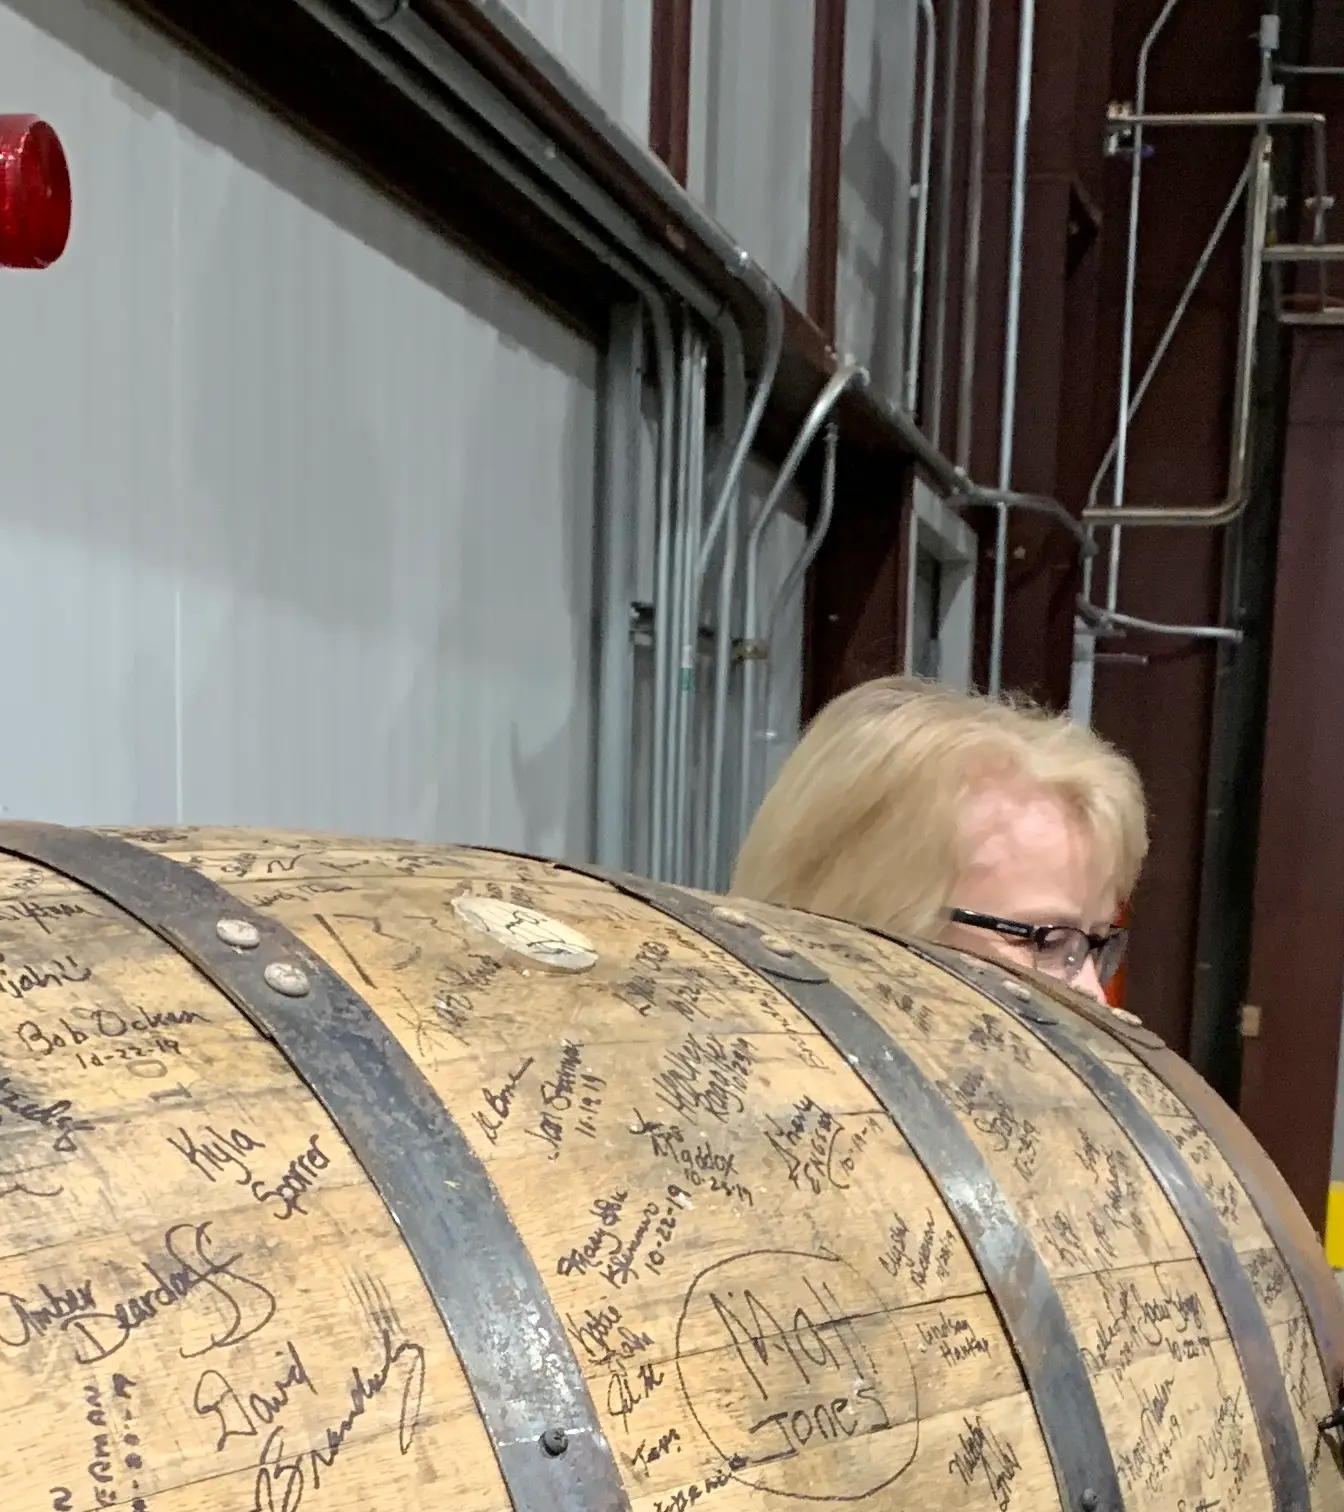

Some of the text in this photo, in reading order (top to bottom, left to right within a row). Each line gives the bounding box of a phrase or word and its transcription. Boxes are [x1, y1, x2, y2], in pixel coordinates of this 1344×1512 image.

[15, 1018, 89, 1056] Bob
[167, 1126, 266, 1185] Kyla
[194, 1341, 320, 1451] David
[748, 1387, 893, 1465] Jones
